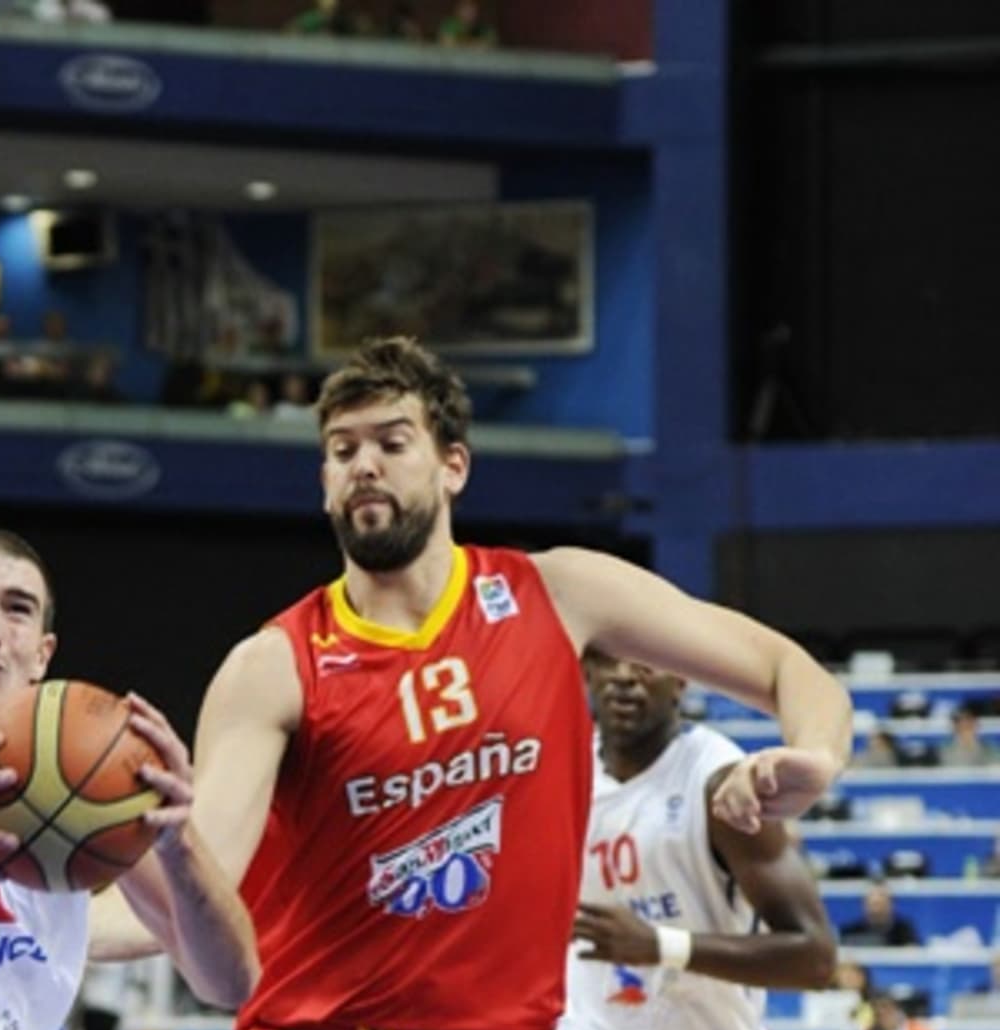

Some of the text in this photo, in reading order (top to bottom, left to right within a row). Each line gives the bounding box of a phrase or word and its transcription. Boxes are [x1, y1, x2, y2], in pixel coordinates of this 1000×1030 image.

[400, 656, 478, 744] 13
[345, 732, 542, 817] España
[590, 833, 640, 892] 10
